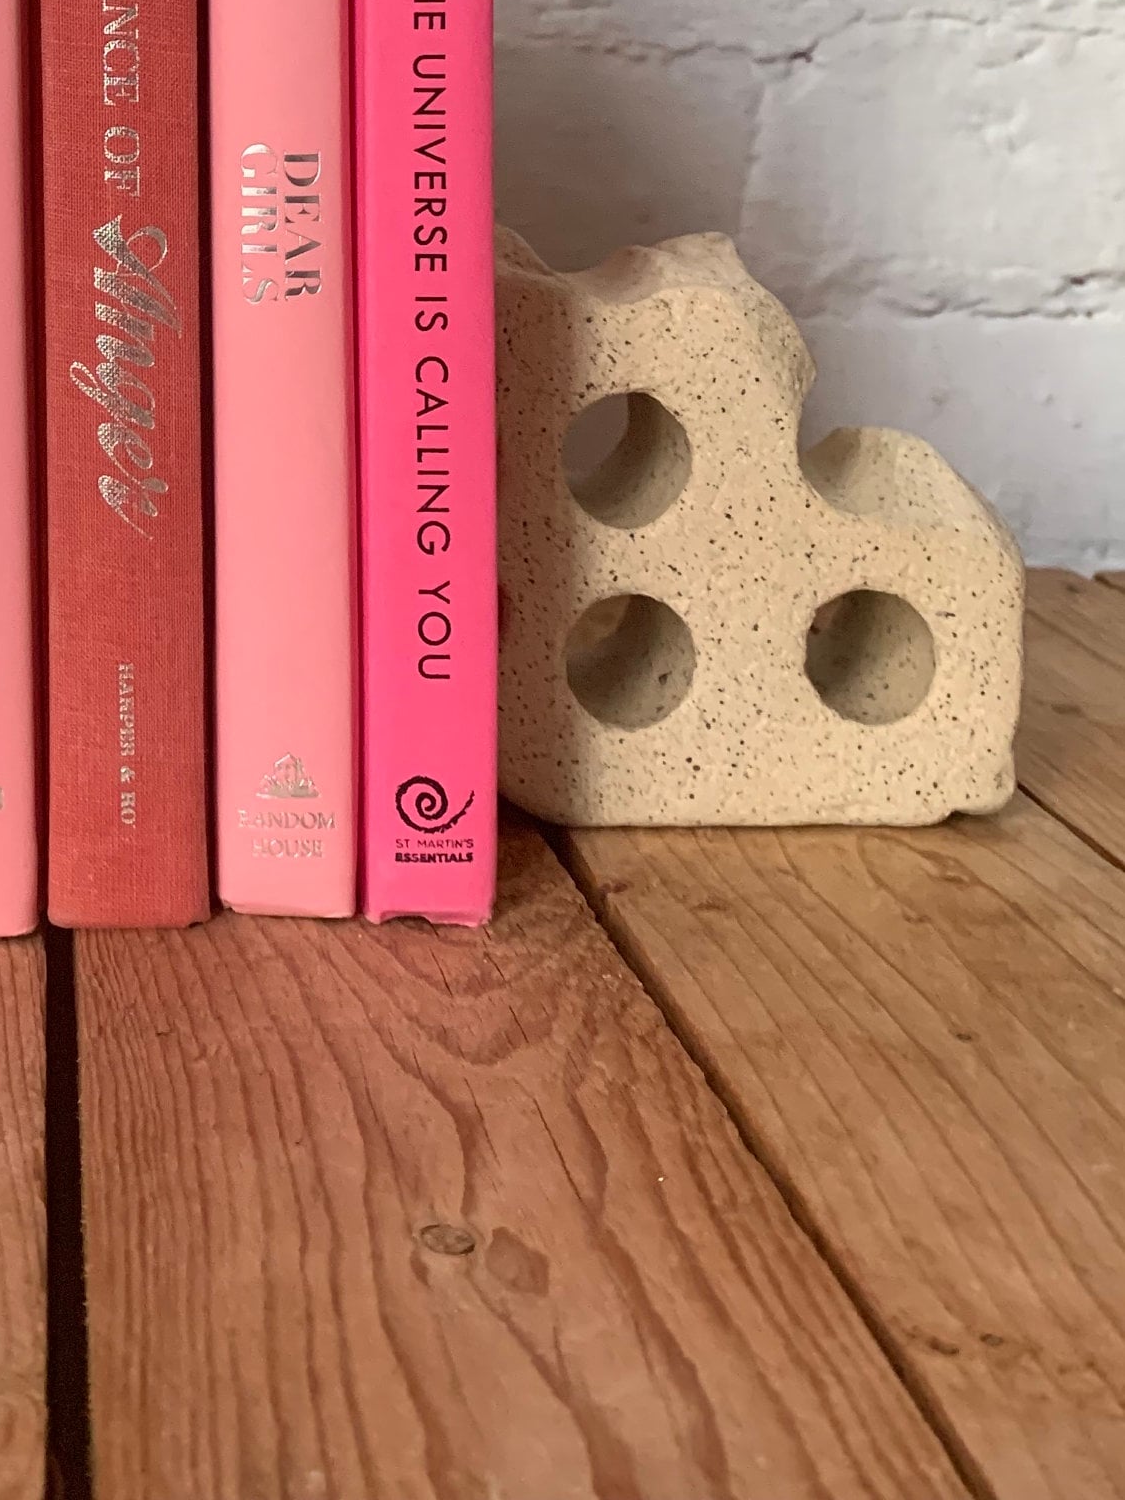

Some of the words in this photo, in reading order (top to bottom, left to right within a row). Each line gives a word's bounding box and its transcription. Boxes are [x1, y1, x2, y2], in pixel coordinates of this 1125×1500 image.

[103, 125, 140, 198] OF
[412, 54, 448, 272] UNIVERSE
[240, 142, 278, 304] GIRLS
[283, 149, 323, 302] DEAR
[414, 296, 449, 332] IS
[69, 213, 182, 541] Anger
[415, 356, 451, 556] CALLING
[417, 580, 452, 680] YOU
[120, 765, 136, 784] &
[237, 810, 336, 830] RANDOM
[251, 838, 323, 858] HOUSE
[417, 838, 474, 849] MARTIN'S
[394, 852, 474, 863] ESSENTIALS
